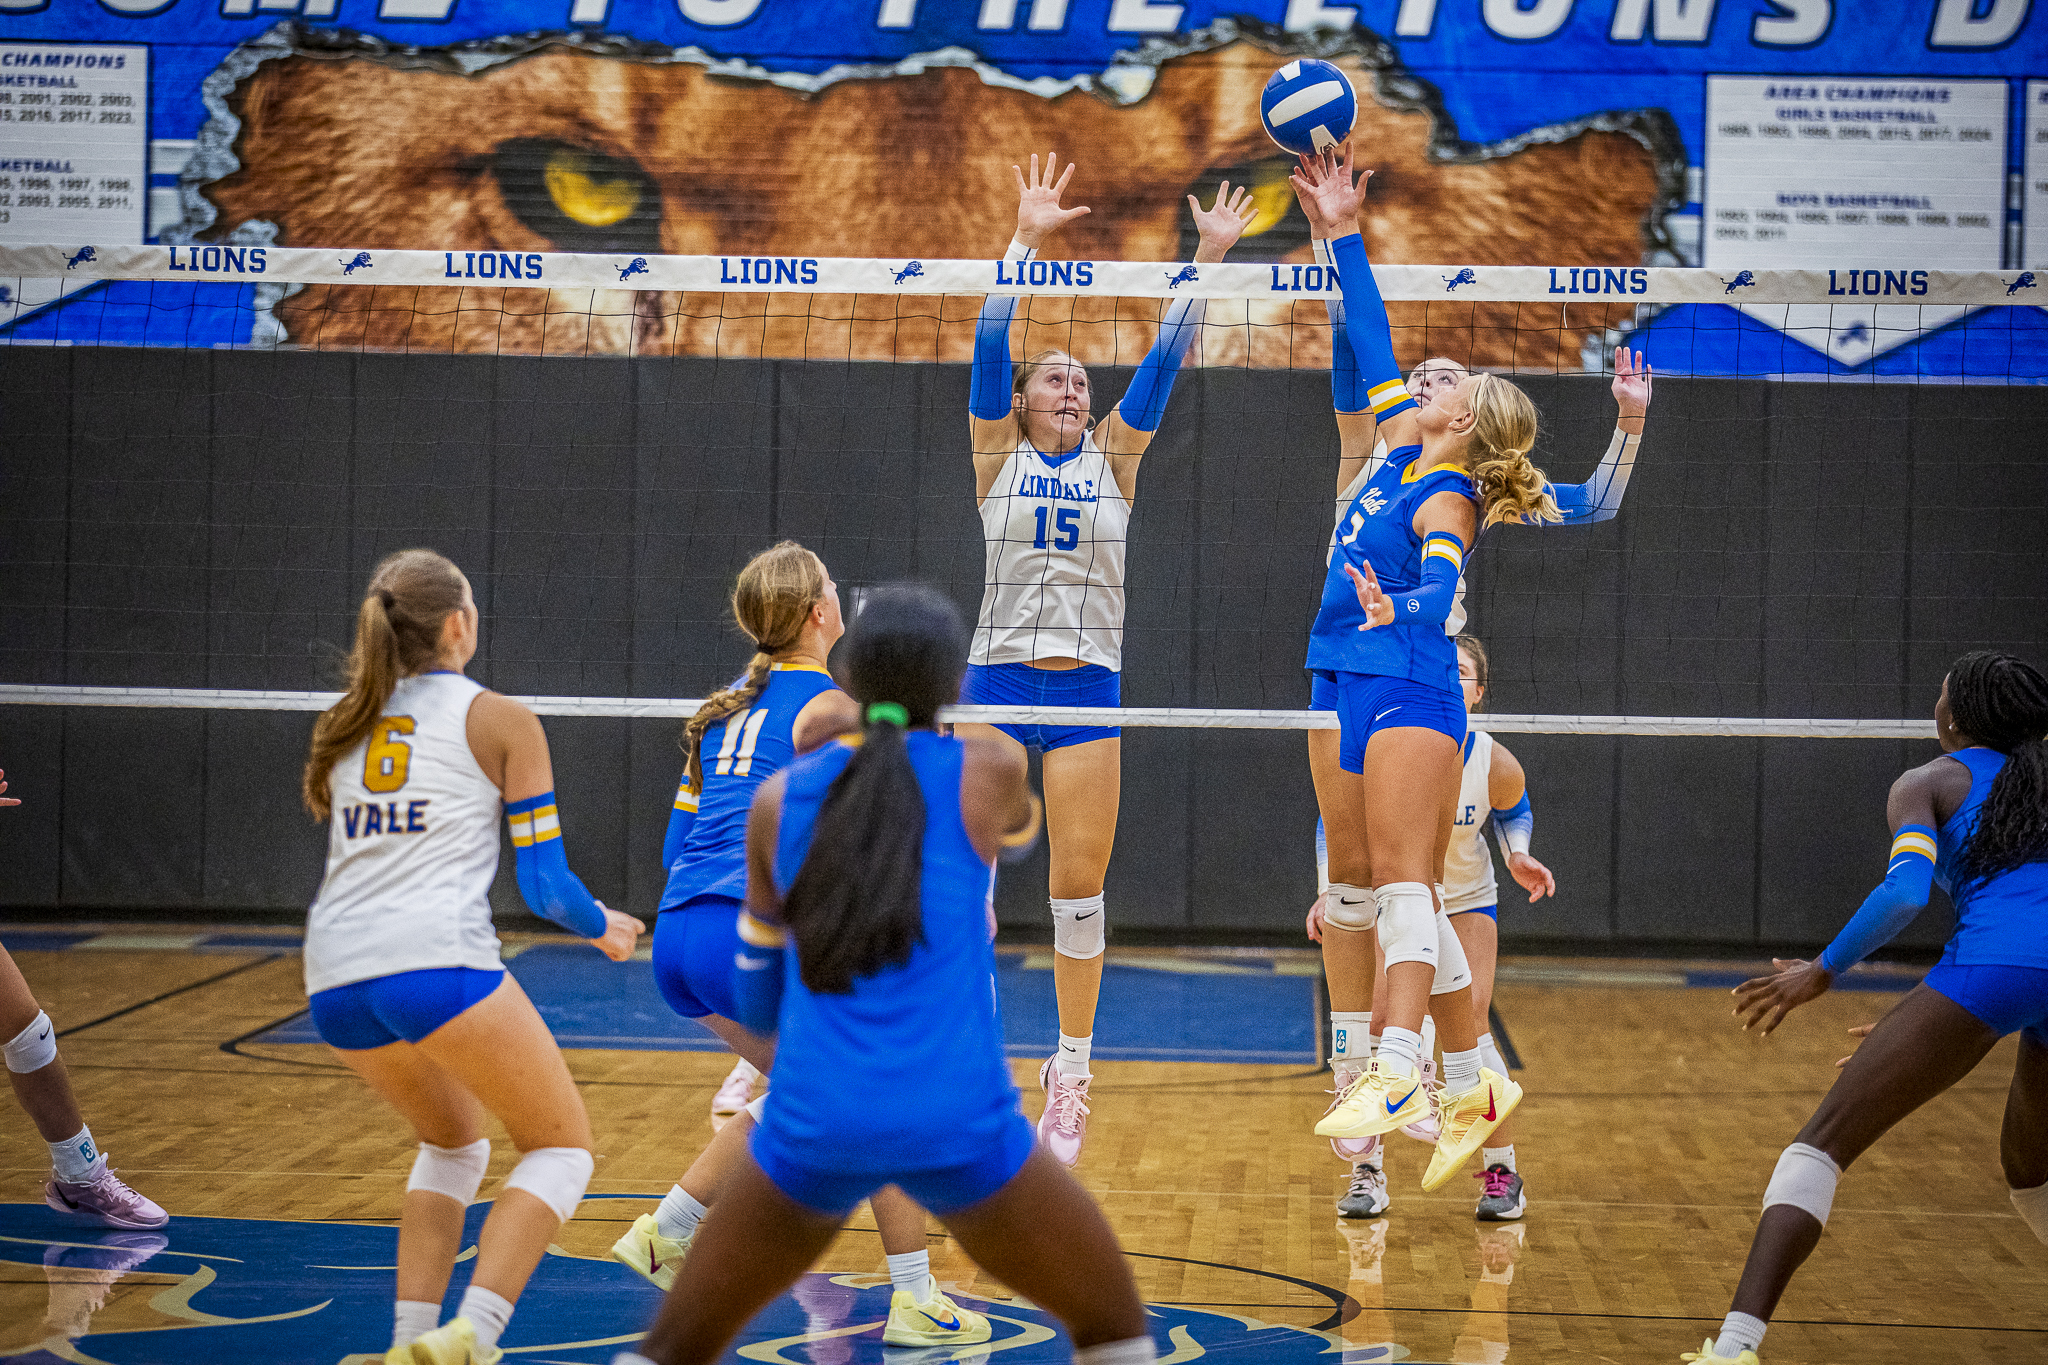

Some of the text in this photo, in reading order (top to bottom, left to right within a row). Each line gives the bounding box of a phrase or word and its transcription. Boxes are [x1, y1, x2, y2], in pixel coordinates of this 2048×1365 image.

[2, 53, 126, 69] CHAMPIONS
[169, 247, 266, 273] LIONS
[445, 253, 542, 279] LIONS
[721, 258, 818, 284] LIONS
[996, 261, 1093, 286] LIONS
[1271, 265, 1341, 291] LION
[1548, 268, 1647, 294] LIONS
[1828, 270, 1928, 295] LIONS
[1018, 474, 1097, 502] LINDALE
[1033, 506, 1081, 551] 15
[362, 715, 418, 794] 6
[716, 709, 769, 776] 11
[343, 800, 430, 839] VALE
